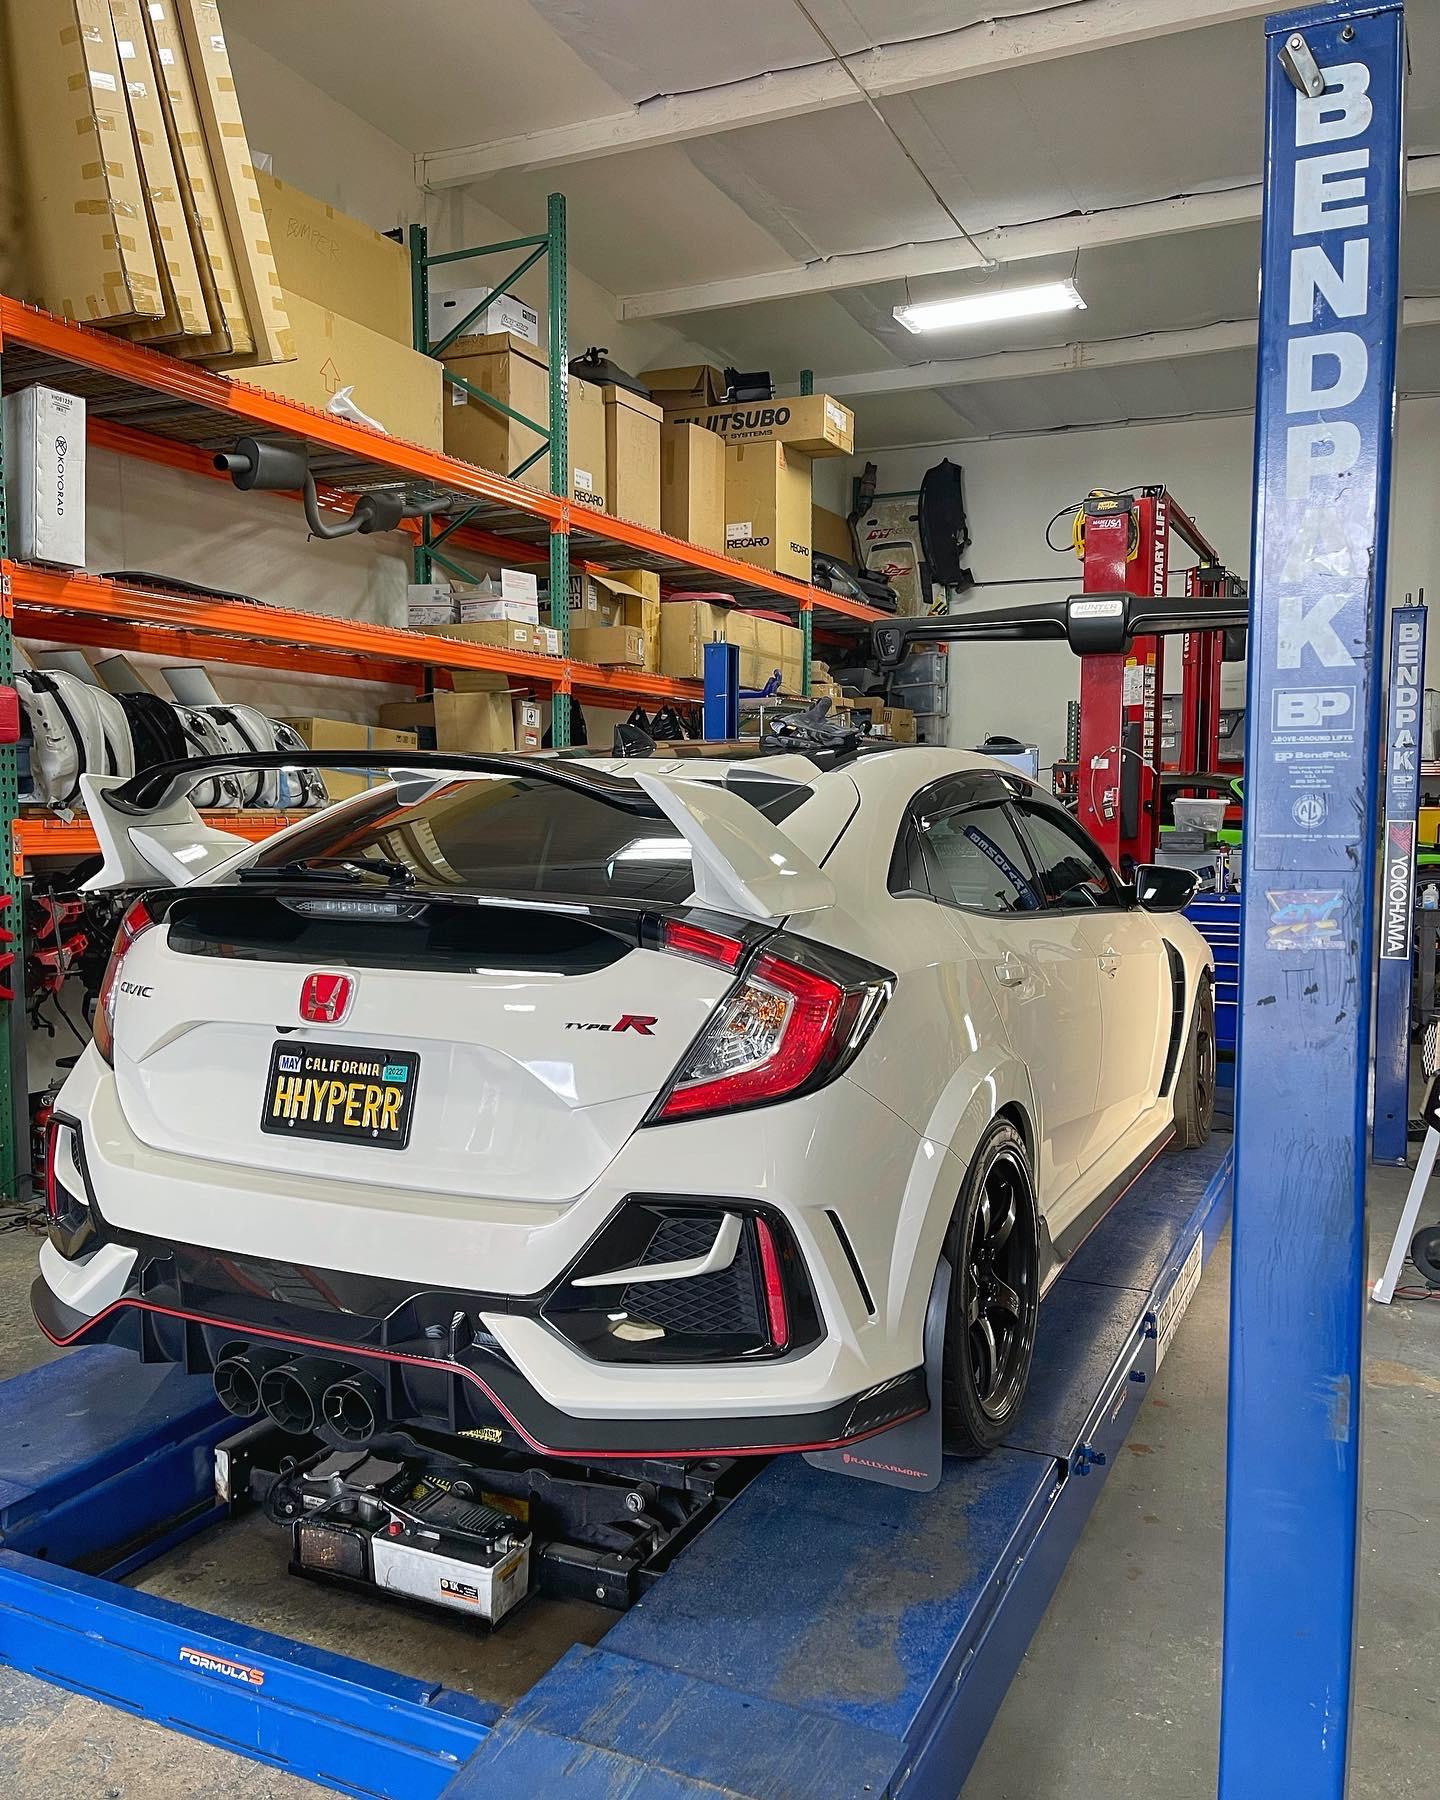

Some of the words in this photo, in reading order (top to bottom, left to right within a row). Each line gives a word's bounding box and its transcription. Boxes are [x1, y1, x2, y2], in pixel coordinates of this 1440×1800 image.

[1277, 61, 1373, 669] BENDPAK
[731, 430, 773, 439] SYSTEMS
[57, 456, 65, 516] KOYORAD
[573, 489, 604, 507] RECARO
[1105, 519, 1122, 528] USA
[1155, 501, 1166, 536] LIFT
[727, 537, 769, 549] RECARO
[790, 542, 810, 556] RECARO
[1393, 623, 1420, 770] BENDPAK
[1278, 692, 1350, 726] BP
[1387, 855, 1408, 953] YOKOHAMA
[121, 981, 155, 998] CIVIC
[565, 1022, 612, 1031] TYPE
[611, 1015, 658, 1035] R
[282, 1056, 300, 1070] MAY
[305, 1057, 380, 1076] CALIFORNIA
[272, 1075, 402, 1131] HHYPERR
